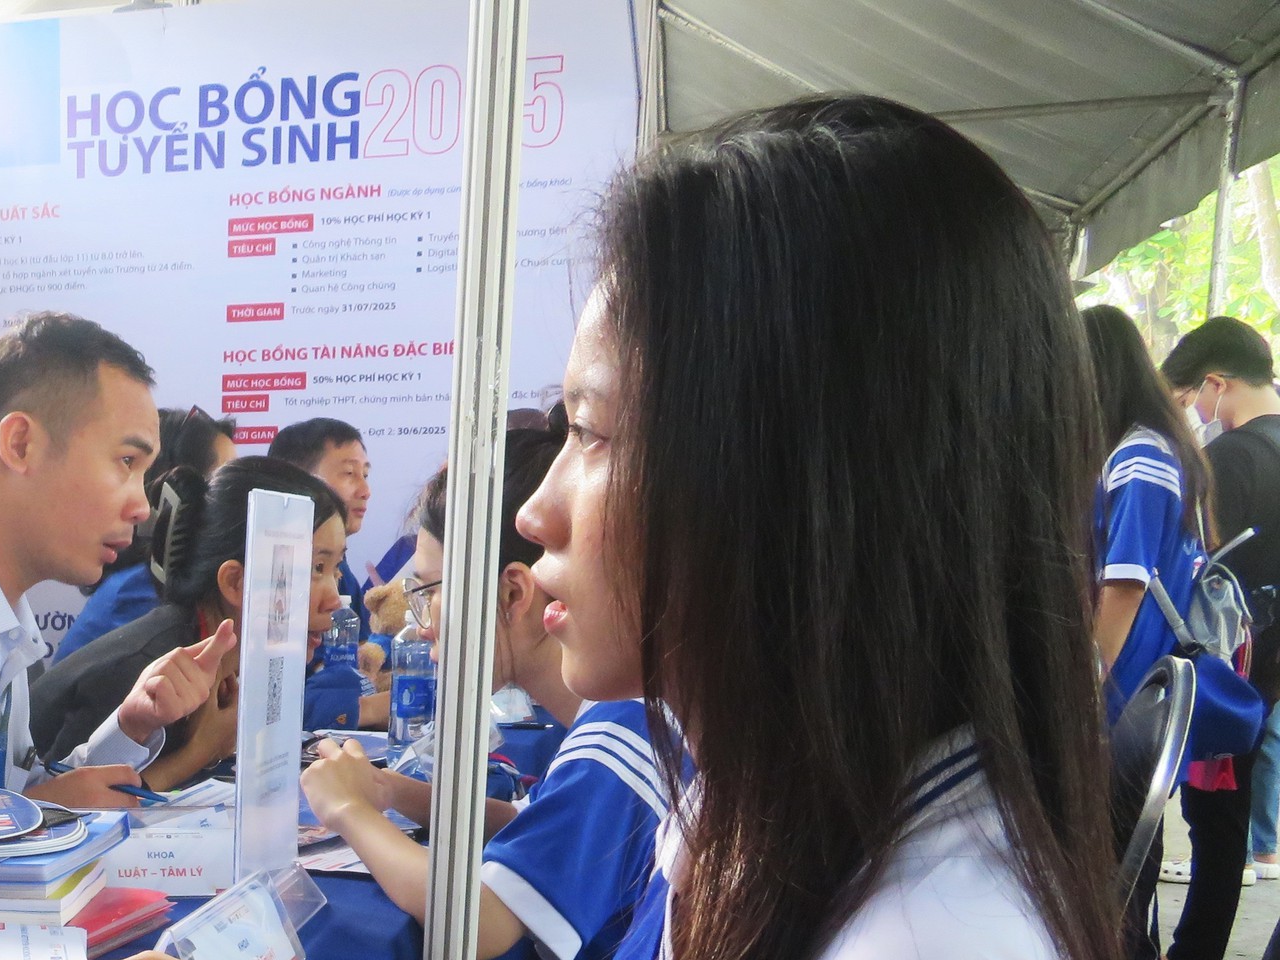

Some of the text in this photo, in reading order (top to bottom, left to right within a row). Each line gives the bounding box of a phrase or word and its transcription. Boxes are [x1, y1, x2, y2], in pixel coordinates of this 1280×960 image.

[66, 66, 361, 145] HỌC BỔNG
[67, 55, 564, 179] TUYỂN SINH 205
[229, 184, 382, 210] HỌC BỔNG NGÀNH
[32, 202, 61, 220] SẮC
[257, 220, 279, 232] HỌC
[280, 218, 309, 230] BỔNG
[321, 216, 342, 226] 10%
[343, 215, 365, 227] HỌC
[367, 212, 384, 223] PHÍ
[386, 212, 408, 224] HỌC
[302, 268, 347, 280] Marketing
[256, 306, 281, 318] GIAN
[341, 301, 397, 313] 31/07/2025
[223, 340, 428, 366] HỌC BỔNG TÀI NĂNG ĐẶC
[226, 375, 302, 389] MỨC HỌC BỔNG
[313, 375, 334, 385] 50%
[336, 373, 357, 386] HỌC
[359, 372, 376, 383] PHÍ
[378, 372, 400, 384] HỌC
[226, 397, 266, 410] TIÊU CHÍ
[389, 393, 414, 403] minh
[251, 429, 274, 440] GIAN
[397, 425, 446, 436] 30/6/2025
[147, 851, 175, 860] KHOA
[118, 865, 204, 881] LUẬT TÂM LÝ
